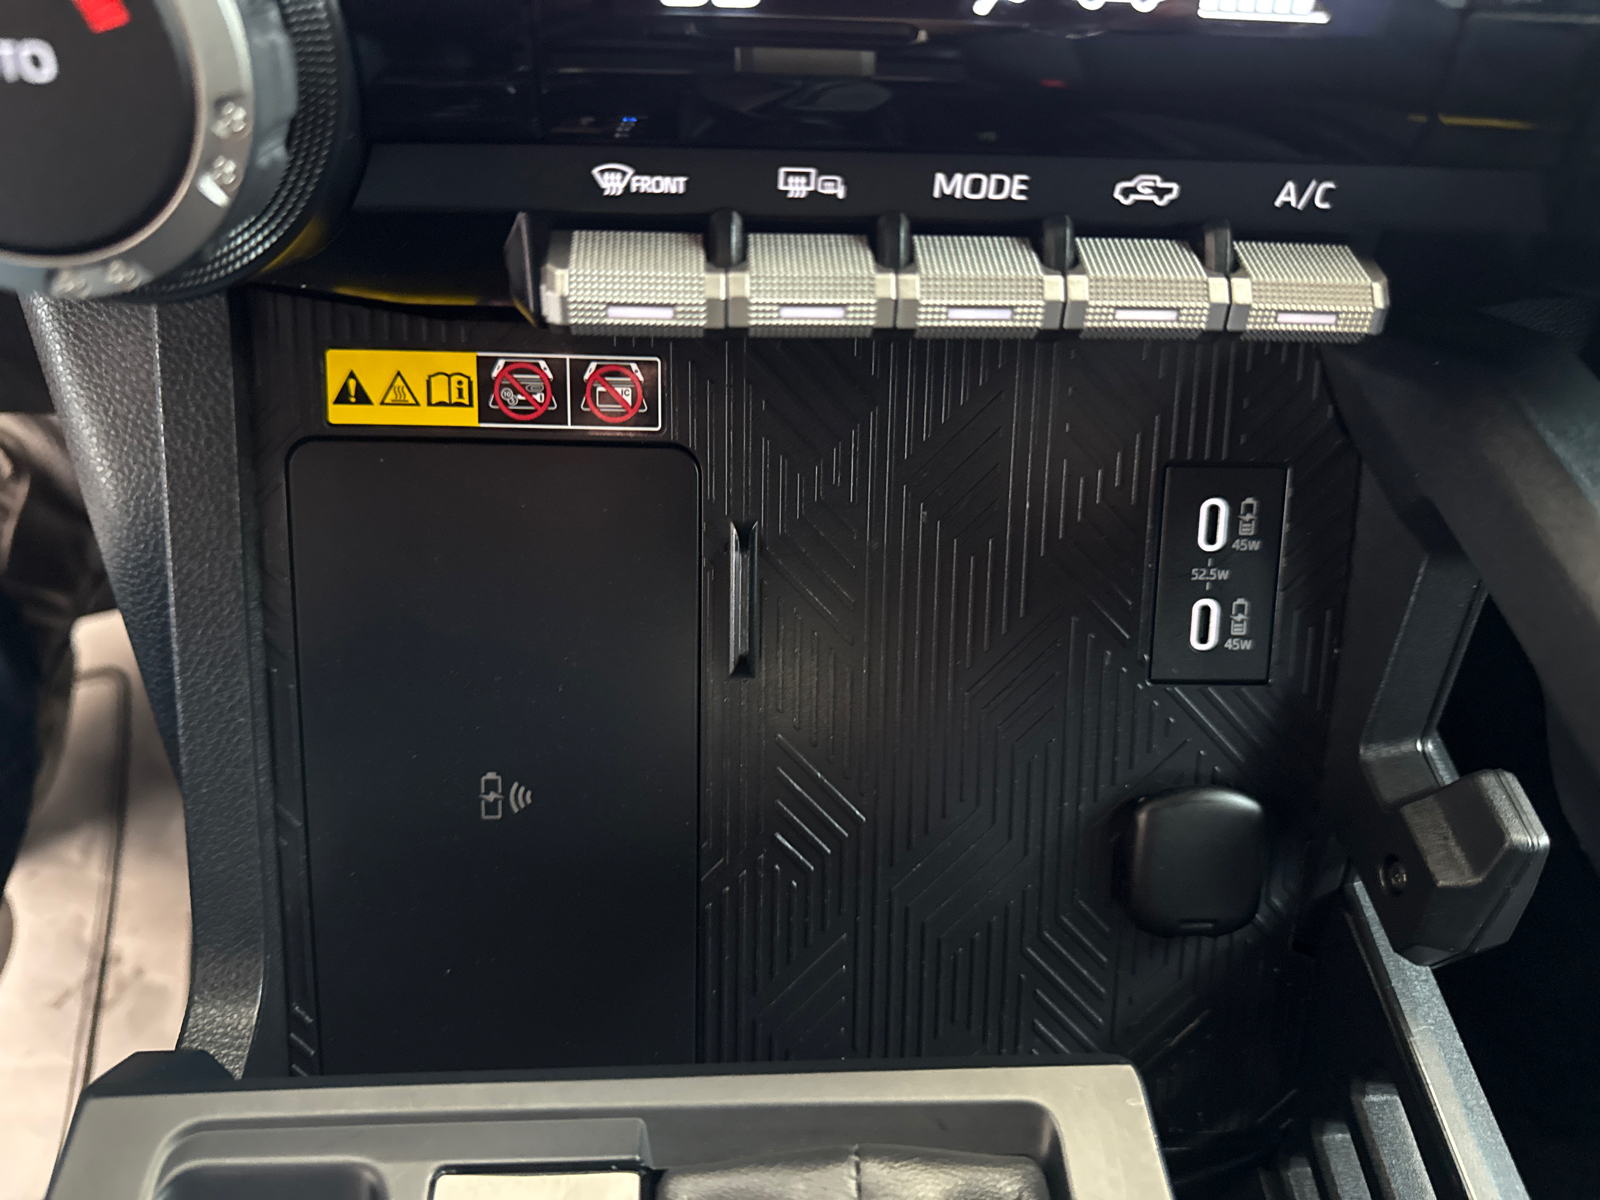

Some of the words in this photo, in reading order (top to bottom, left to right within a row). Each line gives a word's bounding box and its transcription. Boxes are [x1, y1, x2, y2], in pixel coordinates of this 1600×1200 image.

[631, 175, 688, 194] FRONT
[933, 172, 1030, 201] MODE
[1274, 179, 1337, 211] A/C
[620, 389, 631, 397] IC
[1231, 539, 1260, 551] 45W
[1191, 568, 1229, 580] 52.5W
[1224, 638, 1252, 650] 45W
